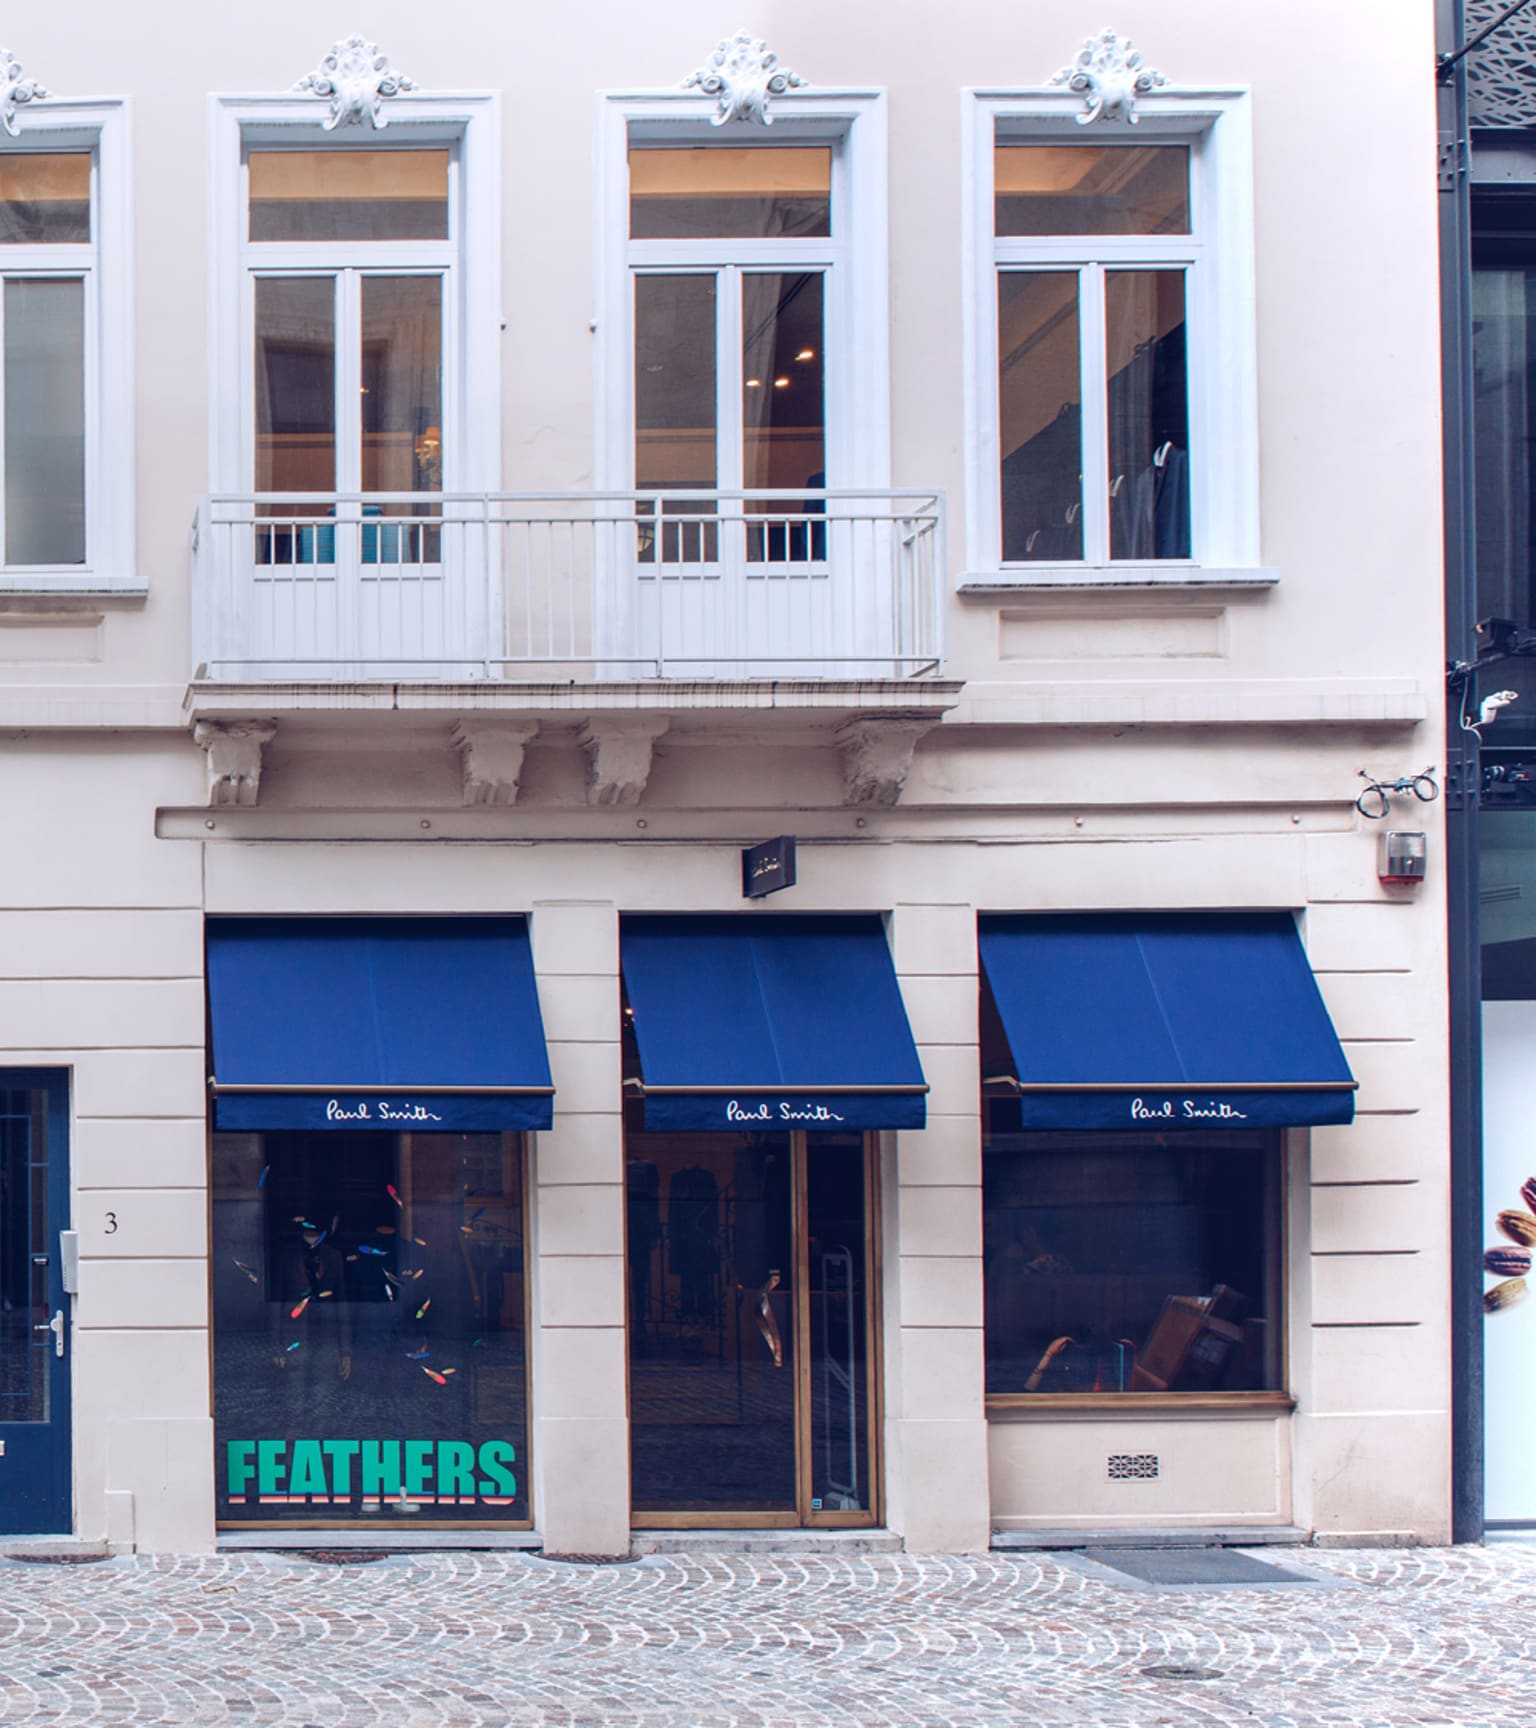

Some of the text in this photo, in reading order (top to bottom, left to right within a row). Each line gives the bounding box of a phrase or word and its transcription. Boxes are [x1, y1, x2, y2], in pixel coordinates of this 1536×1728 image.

[326, 1100, 442, 1121] Paul Smith
[727, 1100, 845, 1121] Paul Smith
[1131, 1098, 1248, 1119] Paul Smith
[104, 1211, 118, 1234] 3
[227, 1440, 516, 1505] FEATHERS
